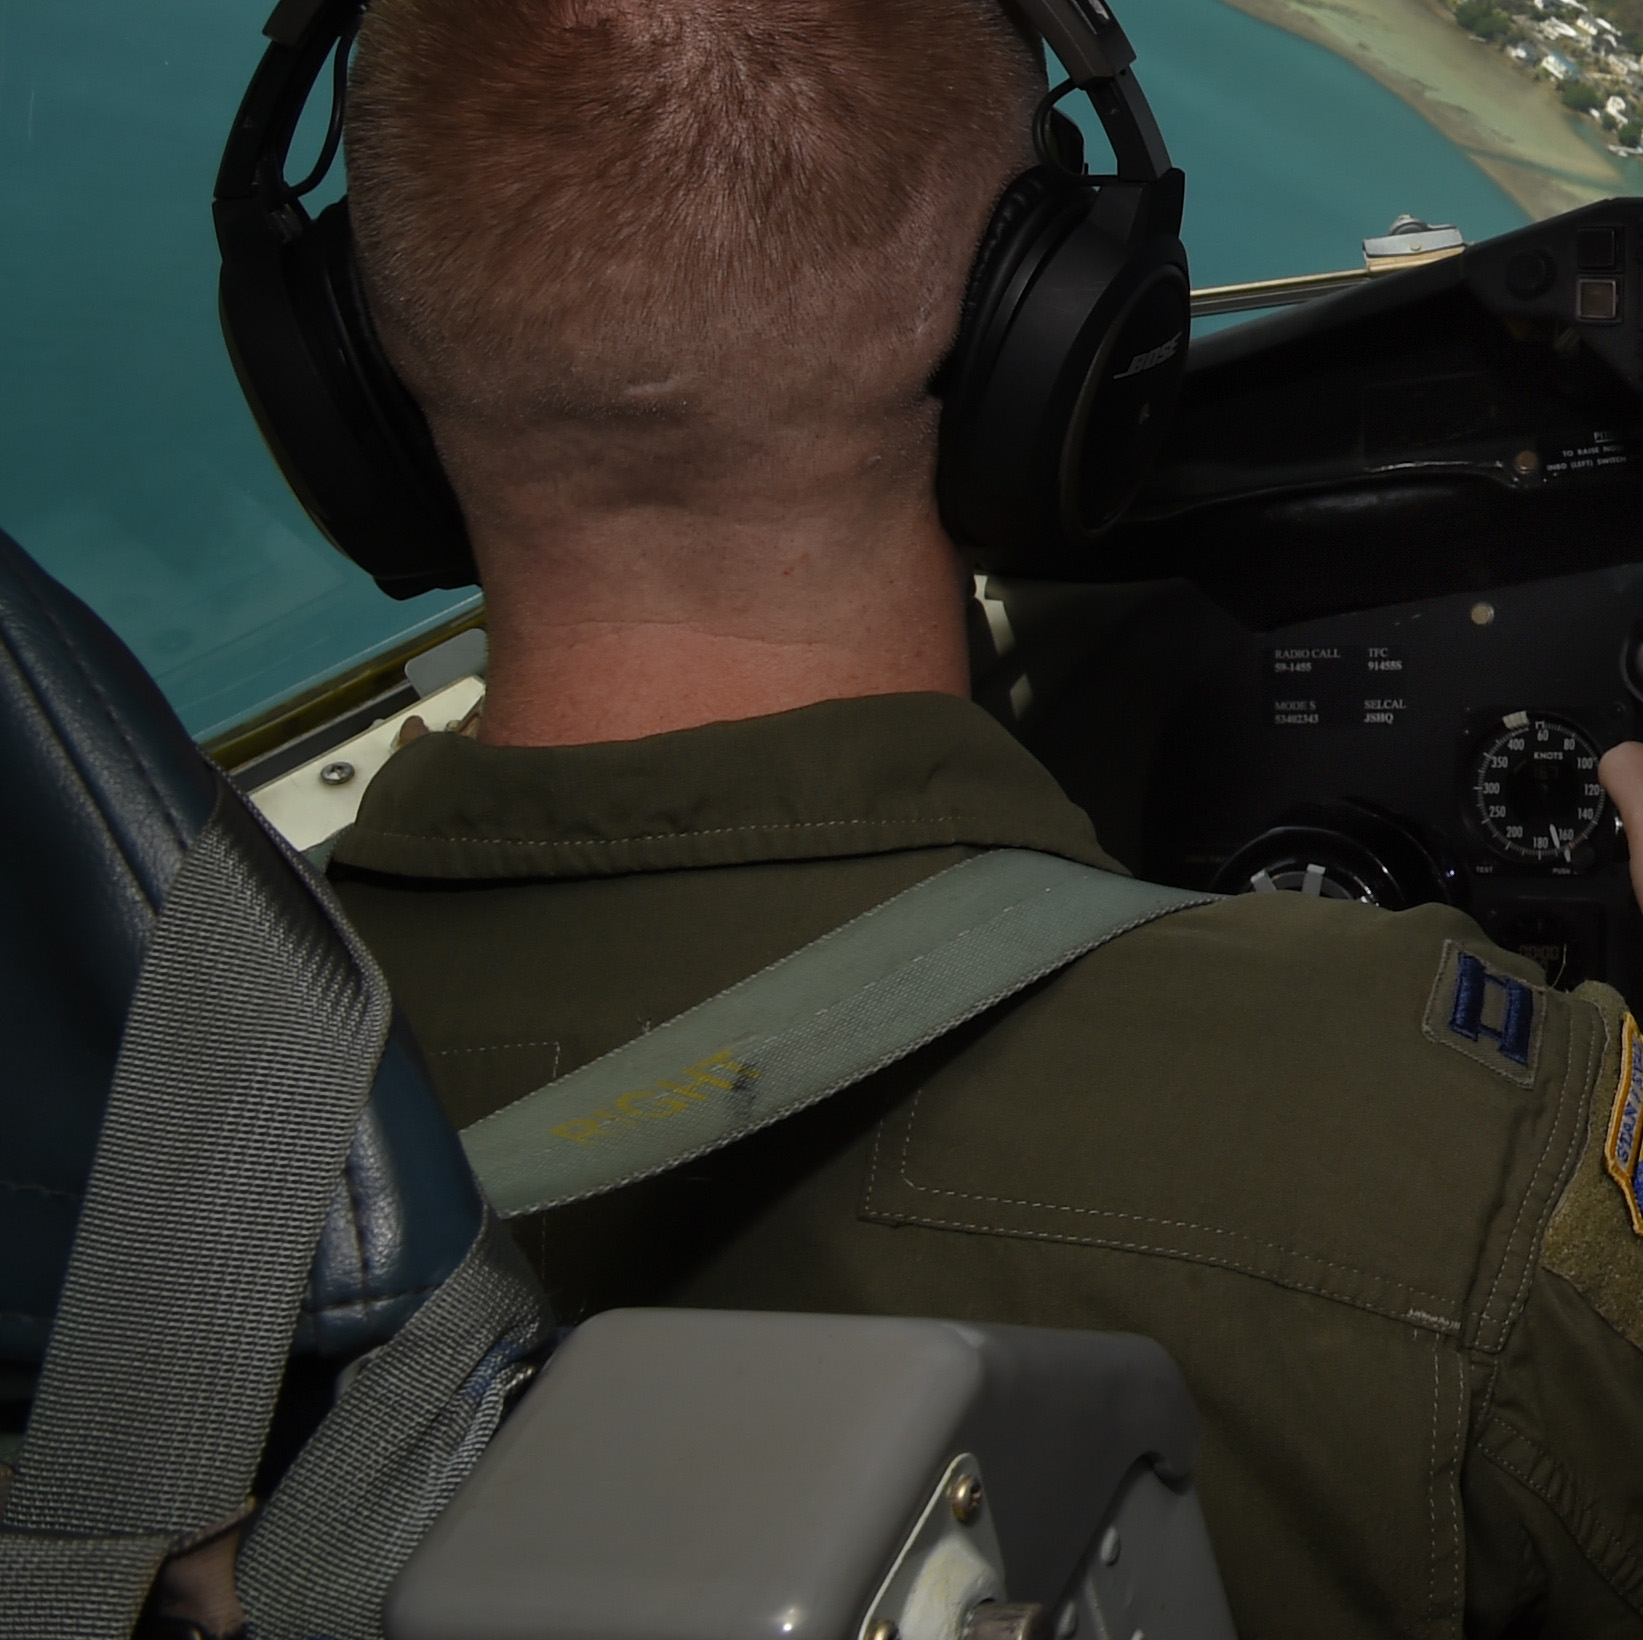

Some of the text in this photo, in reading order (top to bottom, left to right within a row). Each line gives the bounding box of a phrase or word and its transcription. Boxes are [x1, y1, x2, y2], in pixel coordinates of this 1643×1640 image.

[1112, 331, 1182, 381] BOSE
[1275, 649, 1340, 659] RADIO CALL
[1369, 648, 1388, 657] TFC
[1364, 699, 1406, 709] SELCAL
[1364, 712, 1394, 724] JSHQ
[1534, 752, 1563, 760] KNOTS
